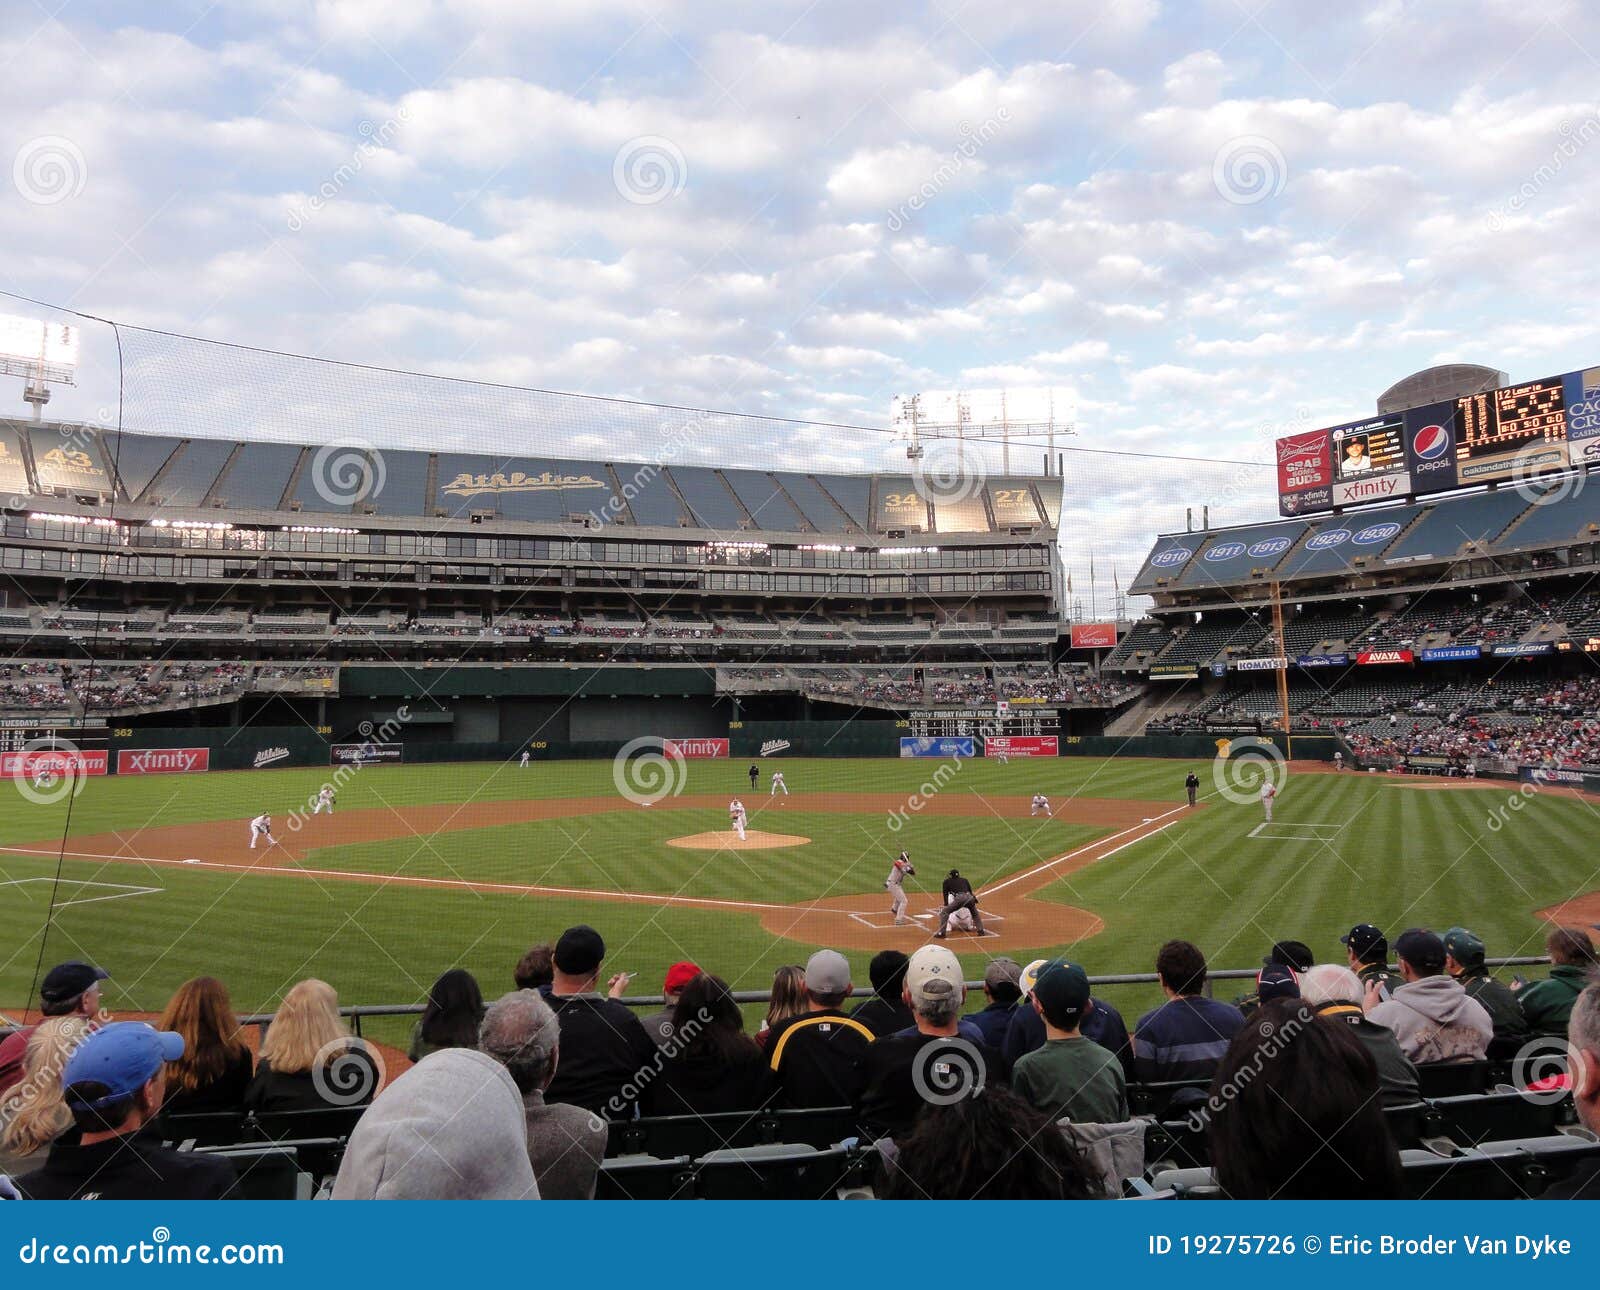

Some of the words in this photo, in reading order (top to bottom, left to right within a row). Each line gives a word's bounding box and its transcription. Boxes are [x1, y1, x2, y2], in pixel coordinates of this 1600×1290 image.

[1285, 457, 1322, 473] GRAB
[1416, 457, 1451, 474] pepsi
[1463, 451, 1561, 476] oaklandathletics.com
[1287, 472, 1322, 488] BUDS
[995, 489, 1027, 503] 27
[1304, 490, 1329, 501] xfinity
[1343, 478, 1398, 501] xfinity
[885, 493, 919, 507] 34
[1310, 532, 1346, 547] 1929
[1358, 526, 1396, 541] 1930
[1209, 544, 1241, 557] 1911
[1254, 539, 1288, 554] 1913
[1156, 550, 1188, 564] 1910
[1433, 649, 1478, 658] SILVERADO
[1520, 644, 1549, 652] LIGHT
[1369, 651, 1401, 661] AVAYA
[910, 711, 933, 719] xfinity
[114, 728, 133, 737] 362
[531, 741, 547, 749] 400
[673, 740, 722, 757] xfinity
[130, 751, 197, 772] xfinity
